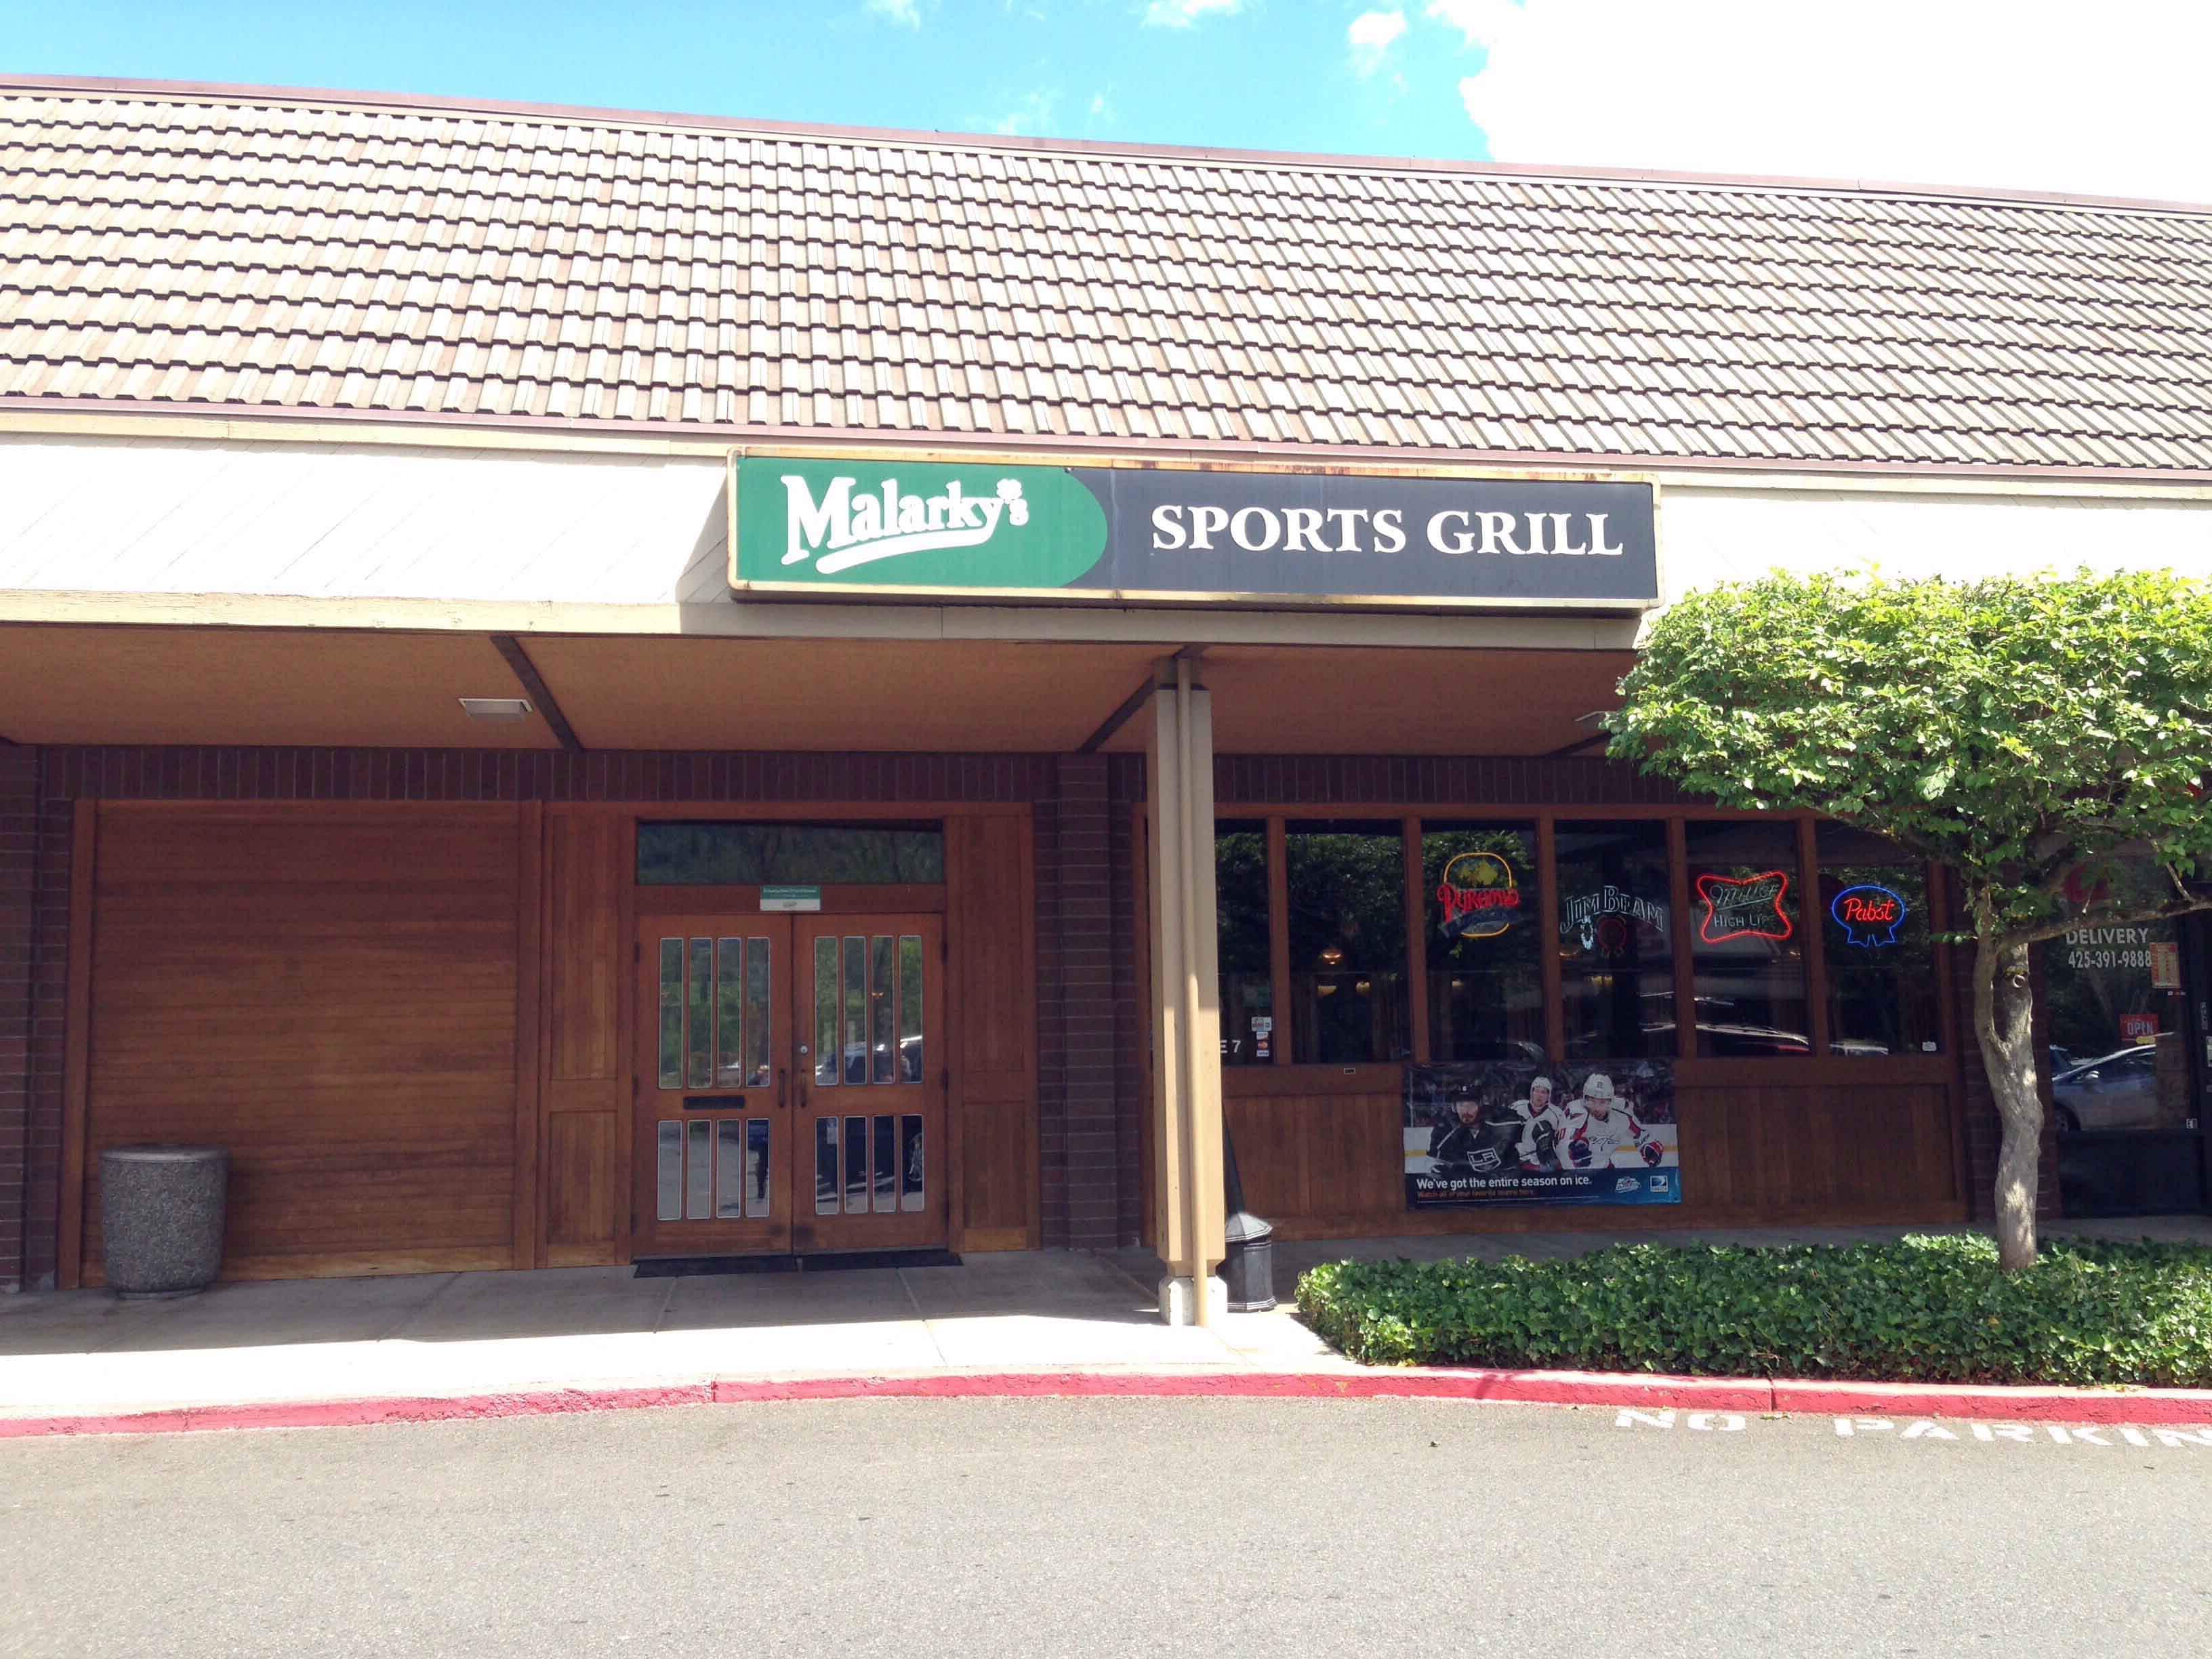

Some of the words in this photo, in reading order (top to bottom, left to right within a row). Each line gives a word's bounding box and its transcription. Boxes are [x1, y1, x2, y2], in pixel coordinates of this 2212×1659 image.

[781, 475, 1029, 574] Malarky's
[1151, 504, 1406, 553] SPORTS
[1426, 510, 1623, 556] GRILL
[1843, 897, 1895, 921] Pabst
[2066, 927, 2149, 945] DELIVERY
[2068, 951, 2152, 969] 425-391-9888
[2127, 1019, 2154, 1036] OPEN
[1232, 1039, 1242, 1054] 7
[1416, 1178, 1448, 1189] We've
[1450, 1178, 1467, 1191] got
[1469, 1177, 1486, 1188] the
[1488, 1176, 1519, 1187] entire
[1521, 1177, 1558, 1186] season
[1560, 1176, 1573, 1186] on
[1616, 1409, 1746, 1431] NO
